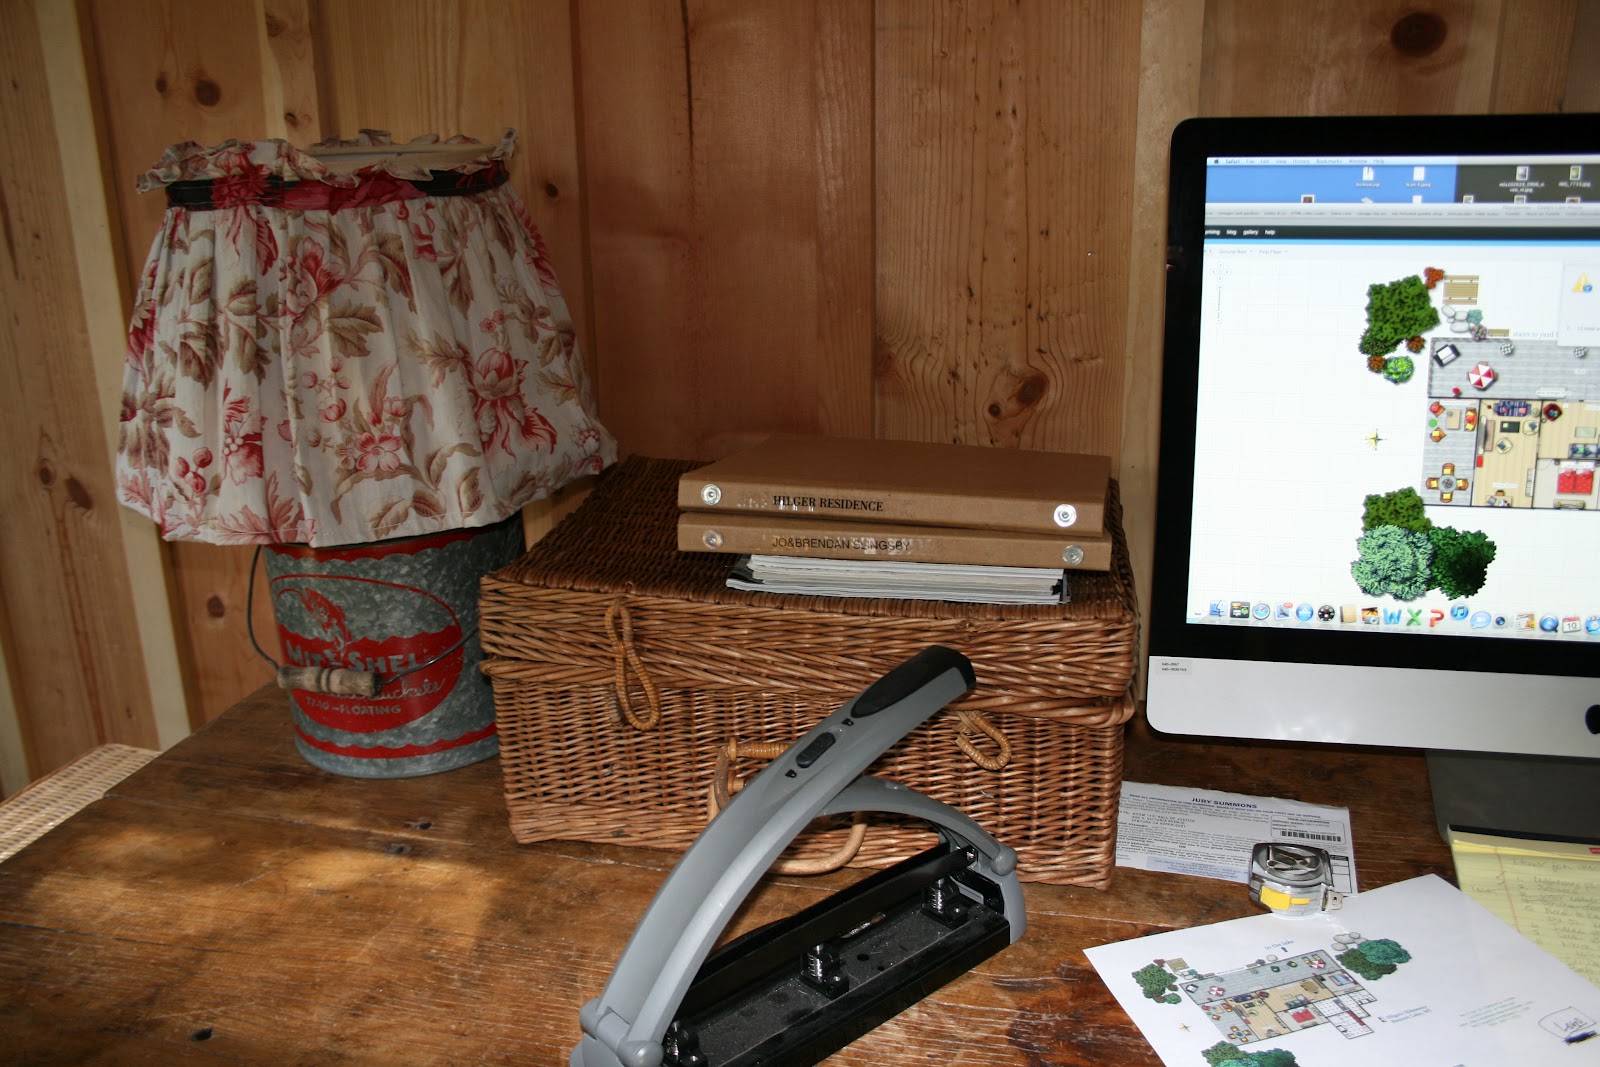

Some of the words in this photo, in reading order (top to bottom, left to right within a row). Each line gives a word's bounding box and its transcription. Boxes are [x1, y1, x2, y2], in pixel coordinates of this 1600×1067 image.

[1205, 228, 1220, 236] pricing
[1226, 228, 1237, 236] blog
[1242, 228, 1259, 236] gallery
[1264, 228, 1275, 236] help
[772, 495, 816, 508] HILGER
[819, 498, 883, 512] RESIDENCE
[772, 537, 850, 549] JO&BRENDAN
[1213, 800, 1258, 809] SUMMONS
